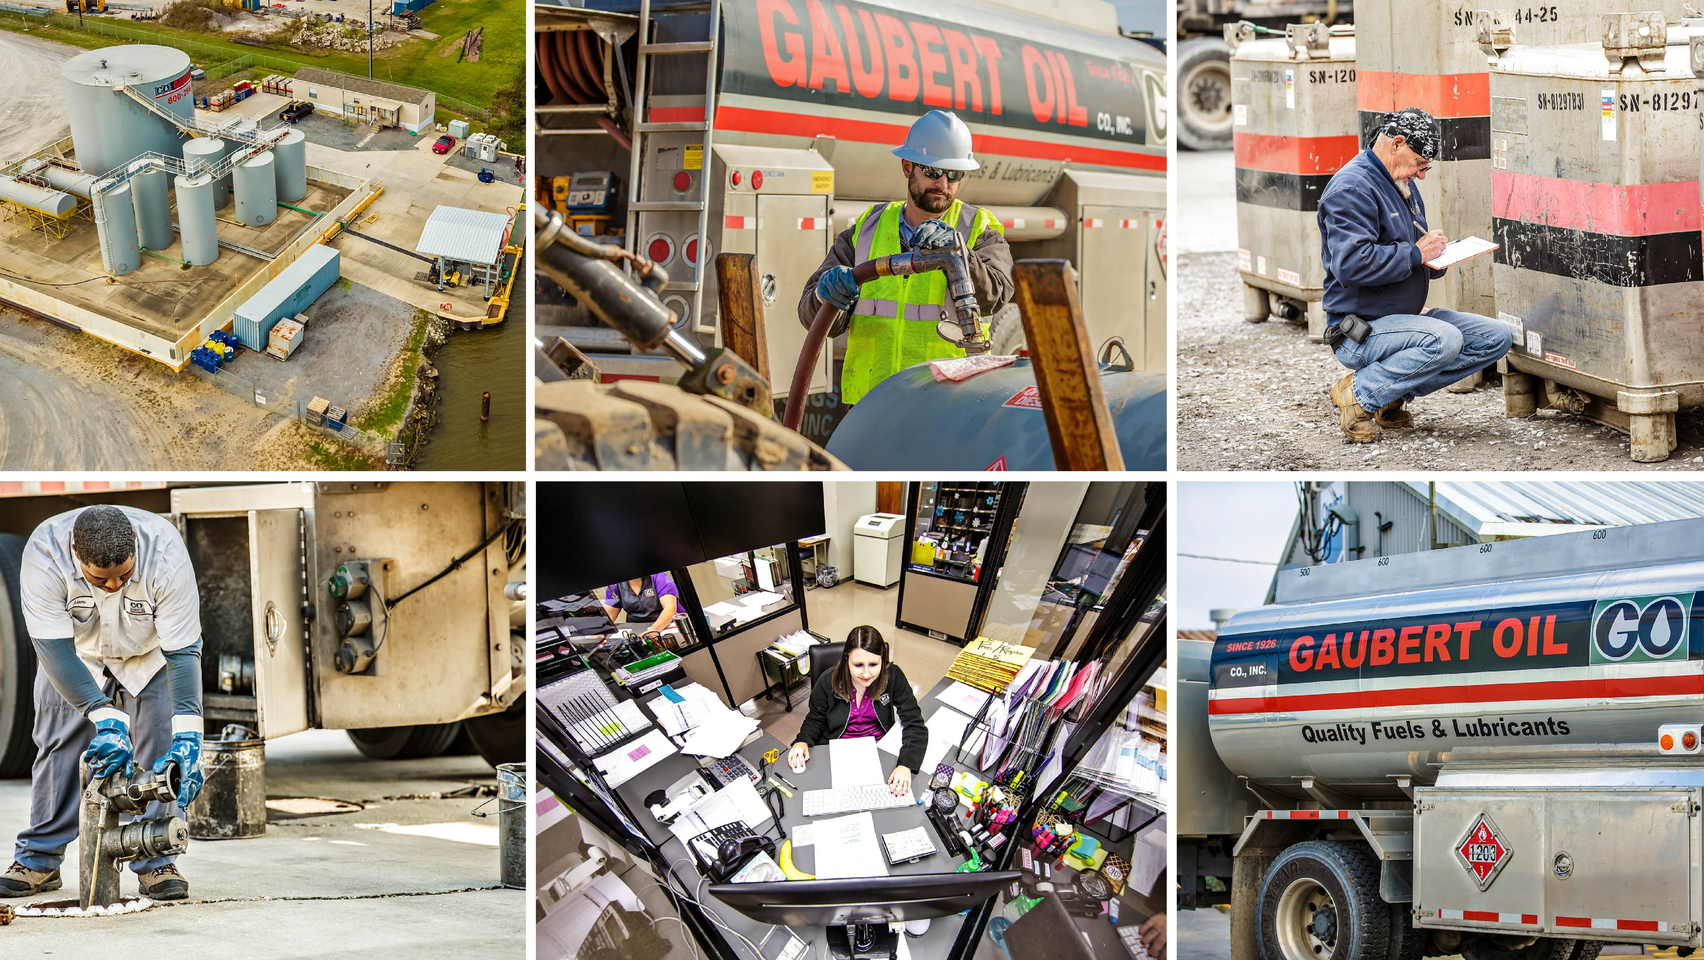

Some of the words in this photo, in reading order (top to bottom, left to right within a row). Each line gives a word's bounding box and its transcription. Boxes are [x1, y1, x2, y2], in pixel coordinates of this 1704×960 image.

[757, 0, 1002, 115] GAUBERT
[1022, 44, 1088, 127] OIL
[1309, 69, 1356, 84] SN-120
[989, 161, 1002, 180] &
[1002, 162, 1056, 183] Lubricants
[1593, 529, 1606, 540] 600
[1479, 543, 1493, 554] 600
[1377, 557, 1390, 567] 600
[1299, 567, 1311, 577] 500
[1289, 621, 1482, 672] GAUBERT
[1492, 615, 1568, 658] OIL
[1593, 596, 1687, 661] GO
[1226, 641, 1254, 652] SINCE
[1255, 639, 1277, 650] 1926
[1230, 666, 1247, 678] CO.,
[1249, 665, 1267, 676] INC.
[1301, 724, 1367, 745] Quality
[1371, 721, 1426, 739] Fuels
[1431, 719, 1448, 738] &
[1452, 716, 1571, 737] Lubricants
[1470, 844, 1496, 862] 1203
